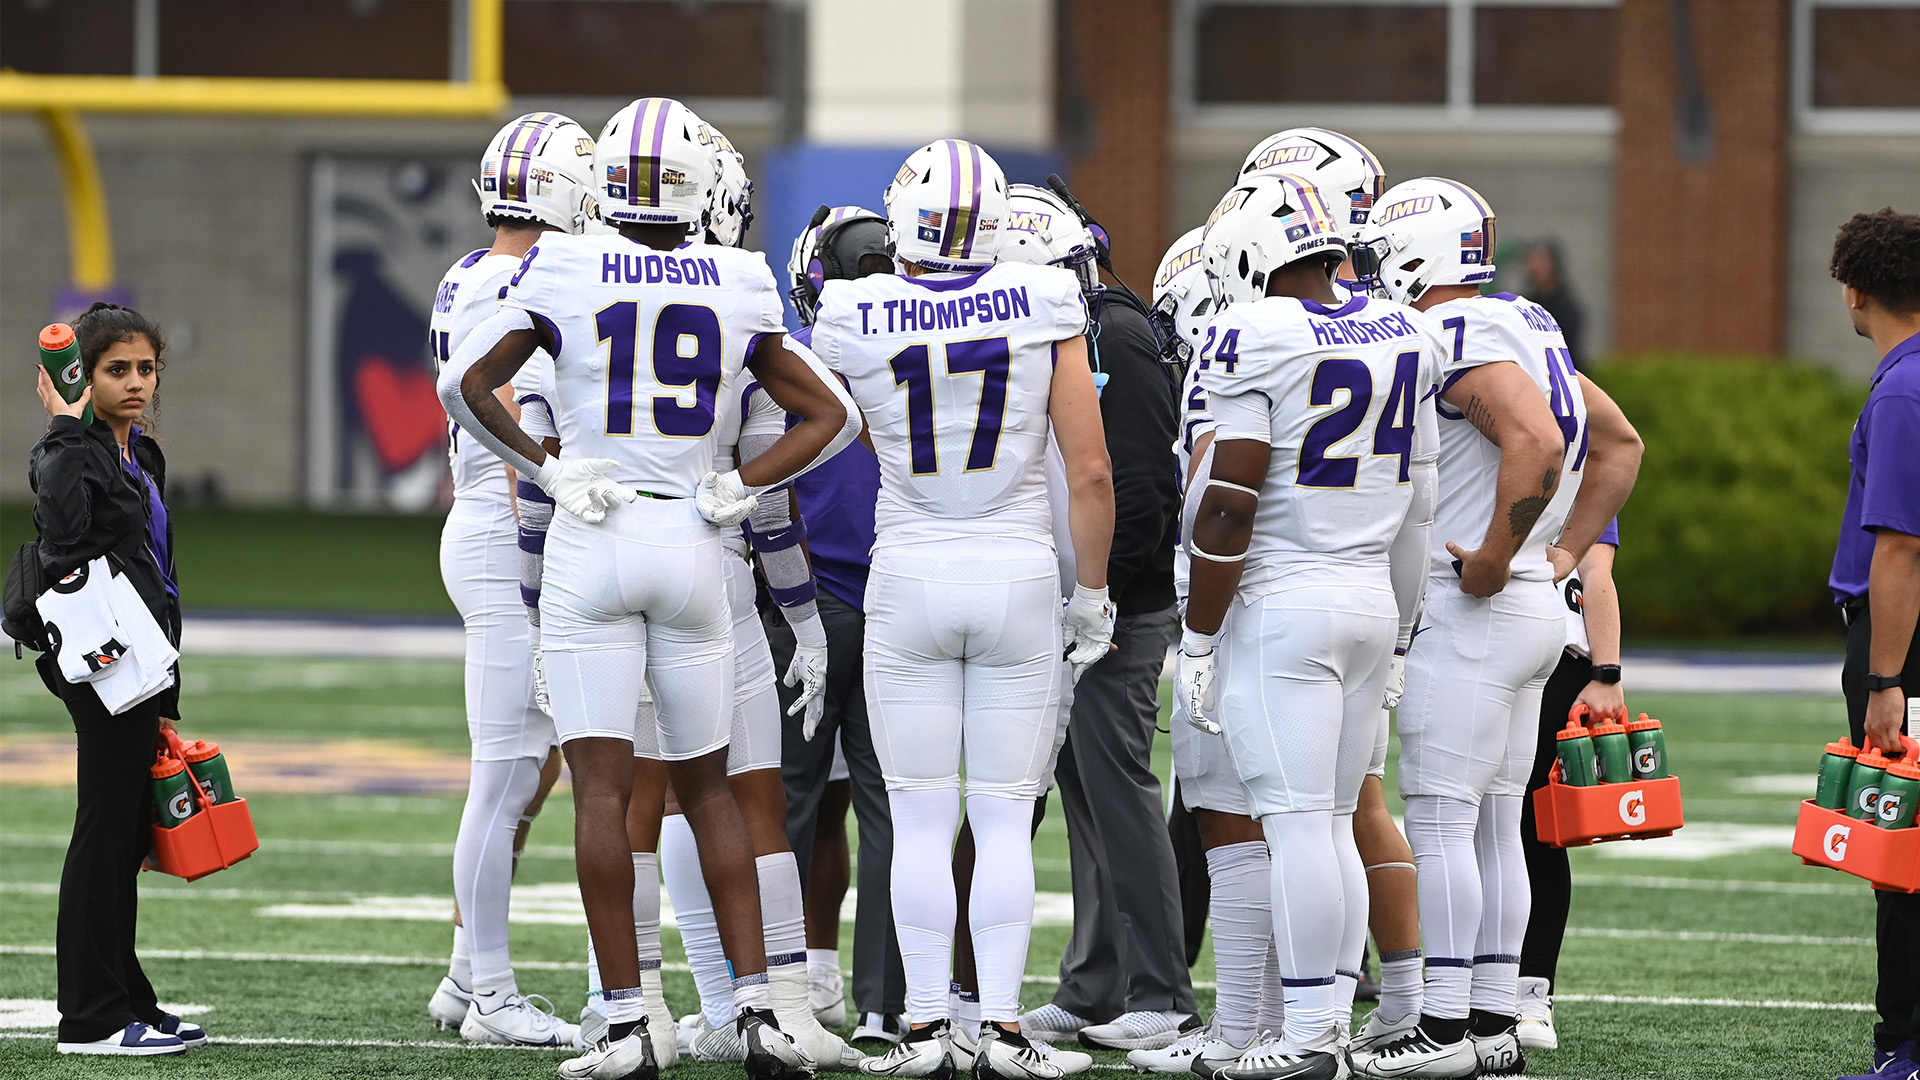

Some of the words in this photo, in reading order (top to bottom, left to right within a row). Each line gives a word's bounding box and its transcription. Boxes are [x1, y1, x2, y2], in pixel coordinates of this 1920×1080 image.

[1258, 146, 1318, 170] JMU
[661, 172, 686, 185] SBC
[611, 211, 637, 220] JAMES
[639, 213, 678, 222] MADISON
[1378, 195, 1435, 227] JMU
[1295, 237, 1325, 254] JAMES
[601, 253, 721, 286] HUDSON
[915, 258, 950, 271] JAMES
[857, 302, 878, 335] T.
[883, 286, 1031, 334] THOMPSON
[1308, 311, 1418, 346] HENDRICK
[1199, 325, 1242, 376] 24
[61, 358, 82, 385] G
[593, 299, 725, 439] 19
[886, 334, 1013, 477] 17
[1294, 349, 1420, 490] 24
[1632, 746, 1657, 775] G
[168, 790, 193, 820] G
[1618, 789, 1646, 826] G
[1877, 793, 1902, 823] G
[1822, 823, 1852, 863] G
